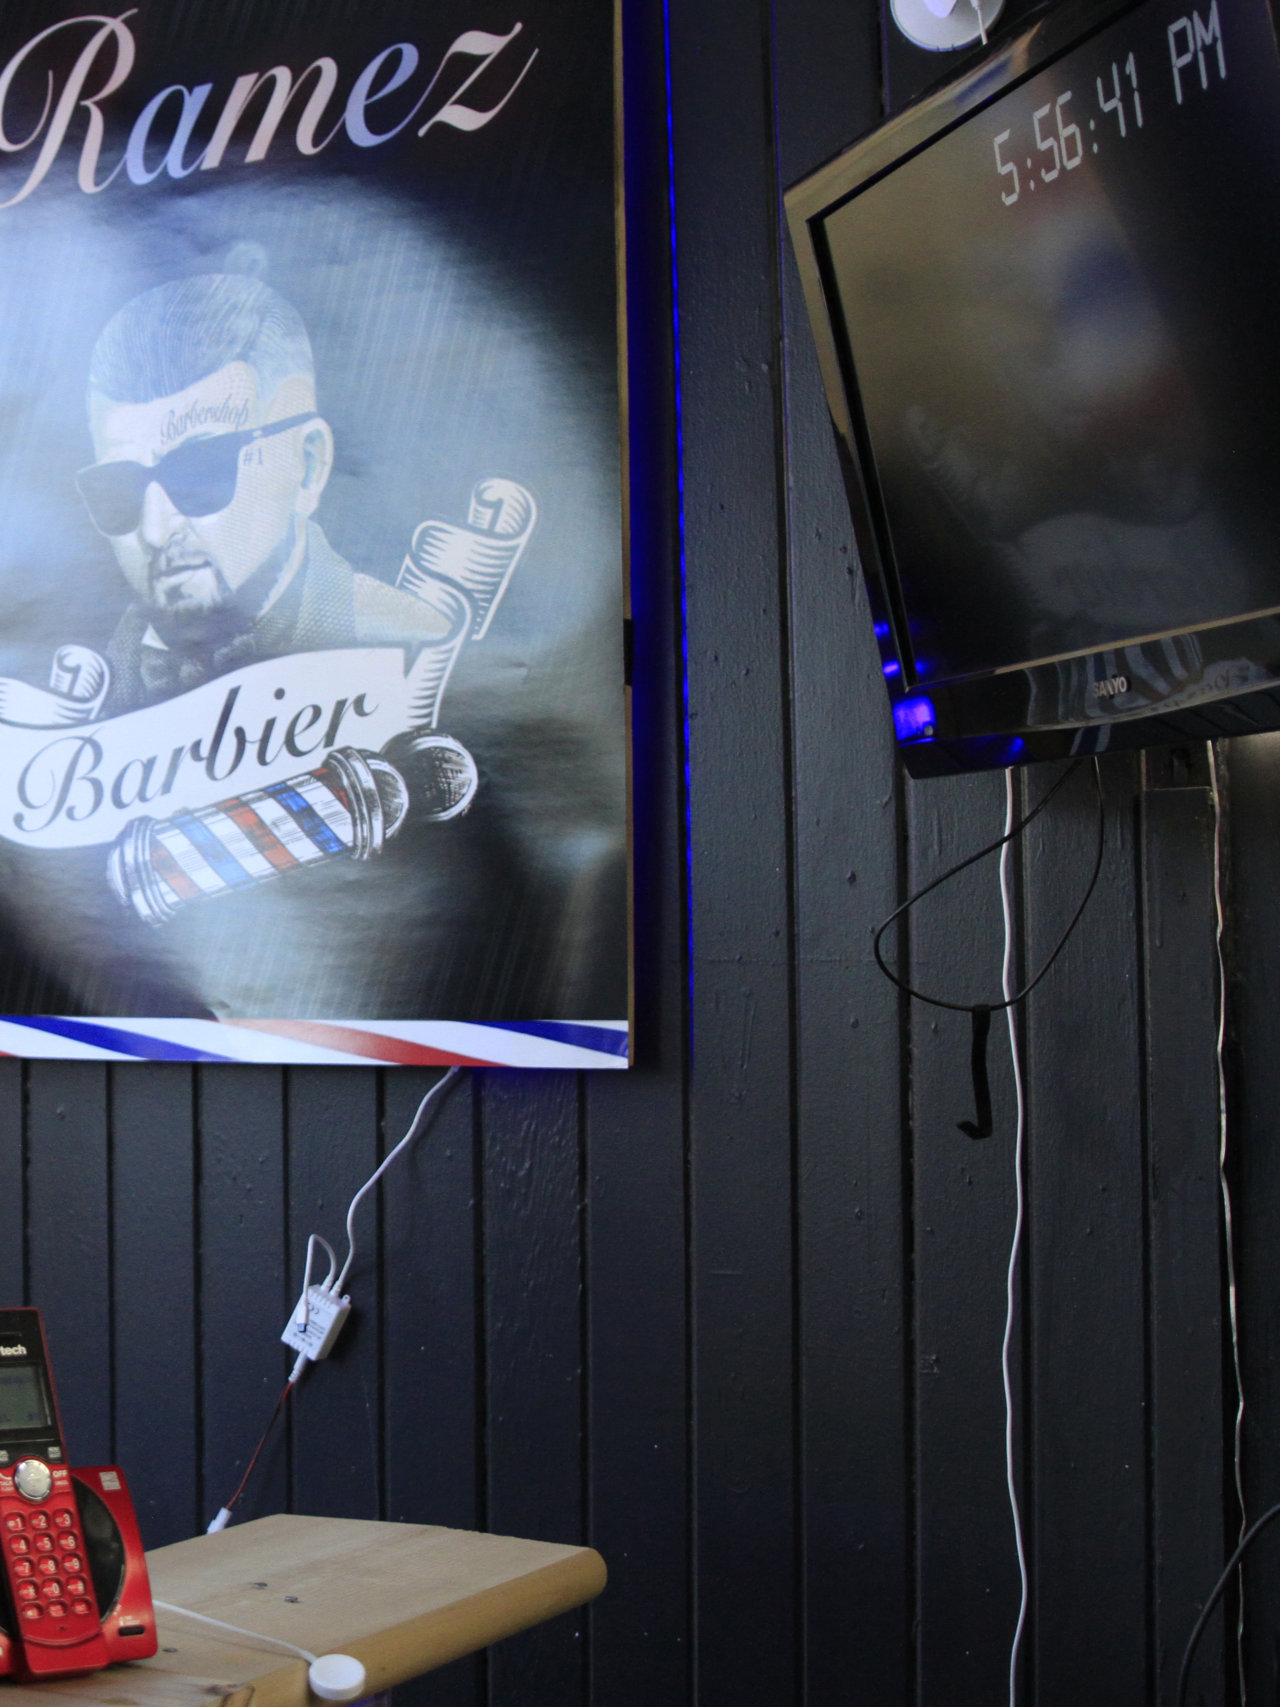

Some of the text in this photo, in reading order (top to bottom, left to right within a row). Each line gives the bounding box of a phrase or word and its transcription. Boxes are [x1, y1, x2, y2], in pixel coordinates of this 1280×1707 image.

[993, 0, 1226, 206] 5:56:41 PM
[160, 393, 249, 446] Barbershop
[12, 685, 379, 834] Barbier
